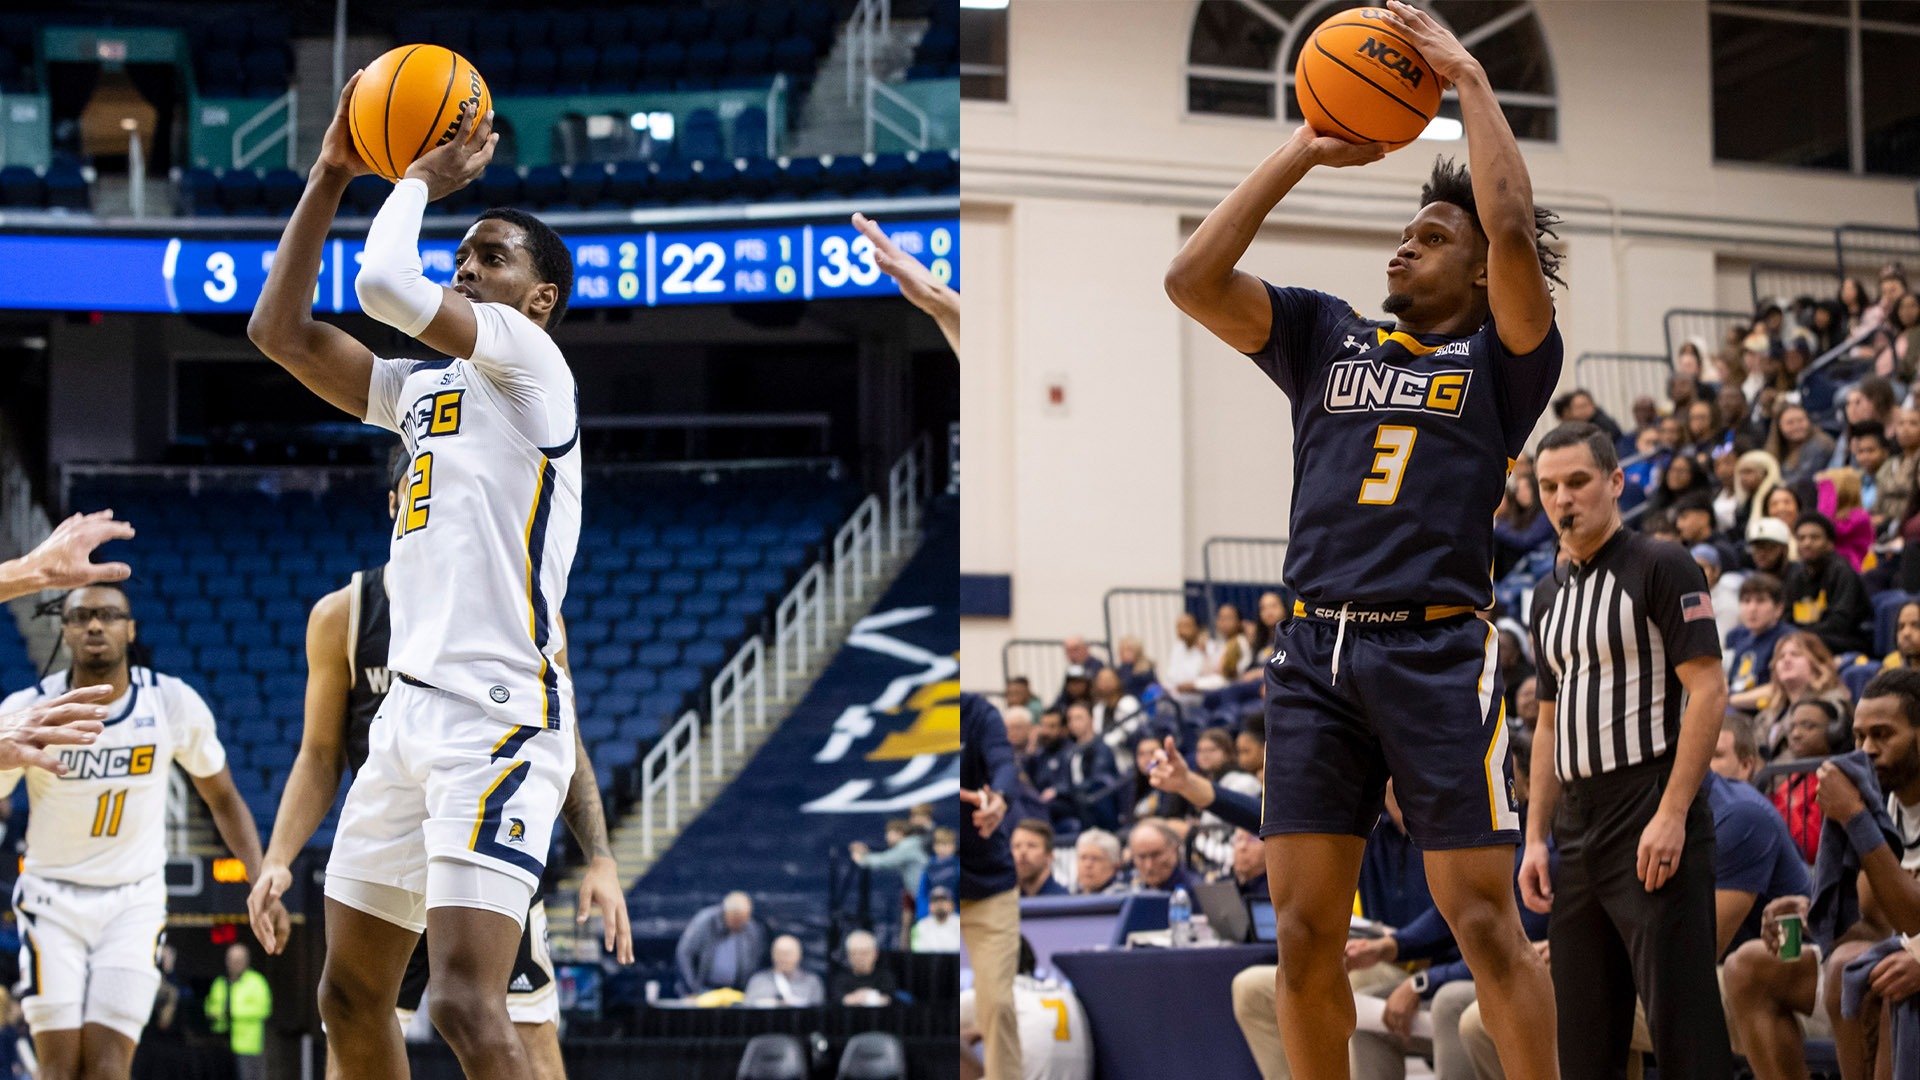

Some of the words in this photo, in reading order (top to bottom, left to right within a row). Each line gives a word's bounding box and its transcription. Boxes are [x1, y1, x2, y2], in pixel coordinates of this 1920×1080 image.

[1358, 36, 1424, 89] NCAA
[618, 241, 639, 270] 2
[778, 235, 791, 263] 1
[818, 235, 881, 287] 33
[930, 228, 952, 256] 0
[203, 251, 237, 303] 3
[617, 271, 640, 300] 0
[661, 242, 726, 295] 22
[775, 265, 797, 293] 0
[1324, 360, 1473, 418] UNCG
[1357, 424, 1418, 505] 3
[1315, 607, 1410, 623] SPARTANS
[57, 744, 156, 780] UNCG
[90, 788, 128, 837] 11
[1040, 998, 1071, 1042] 7
